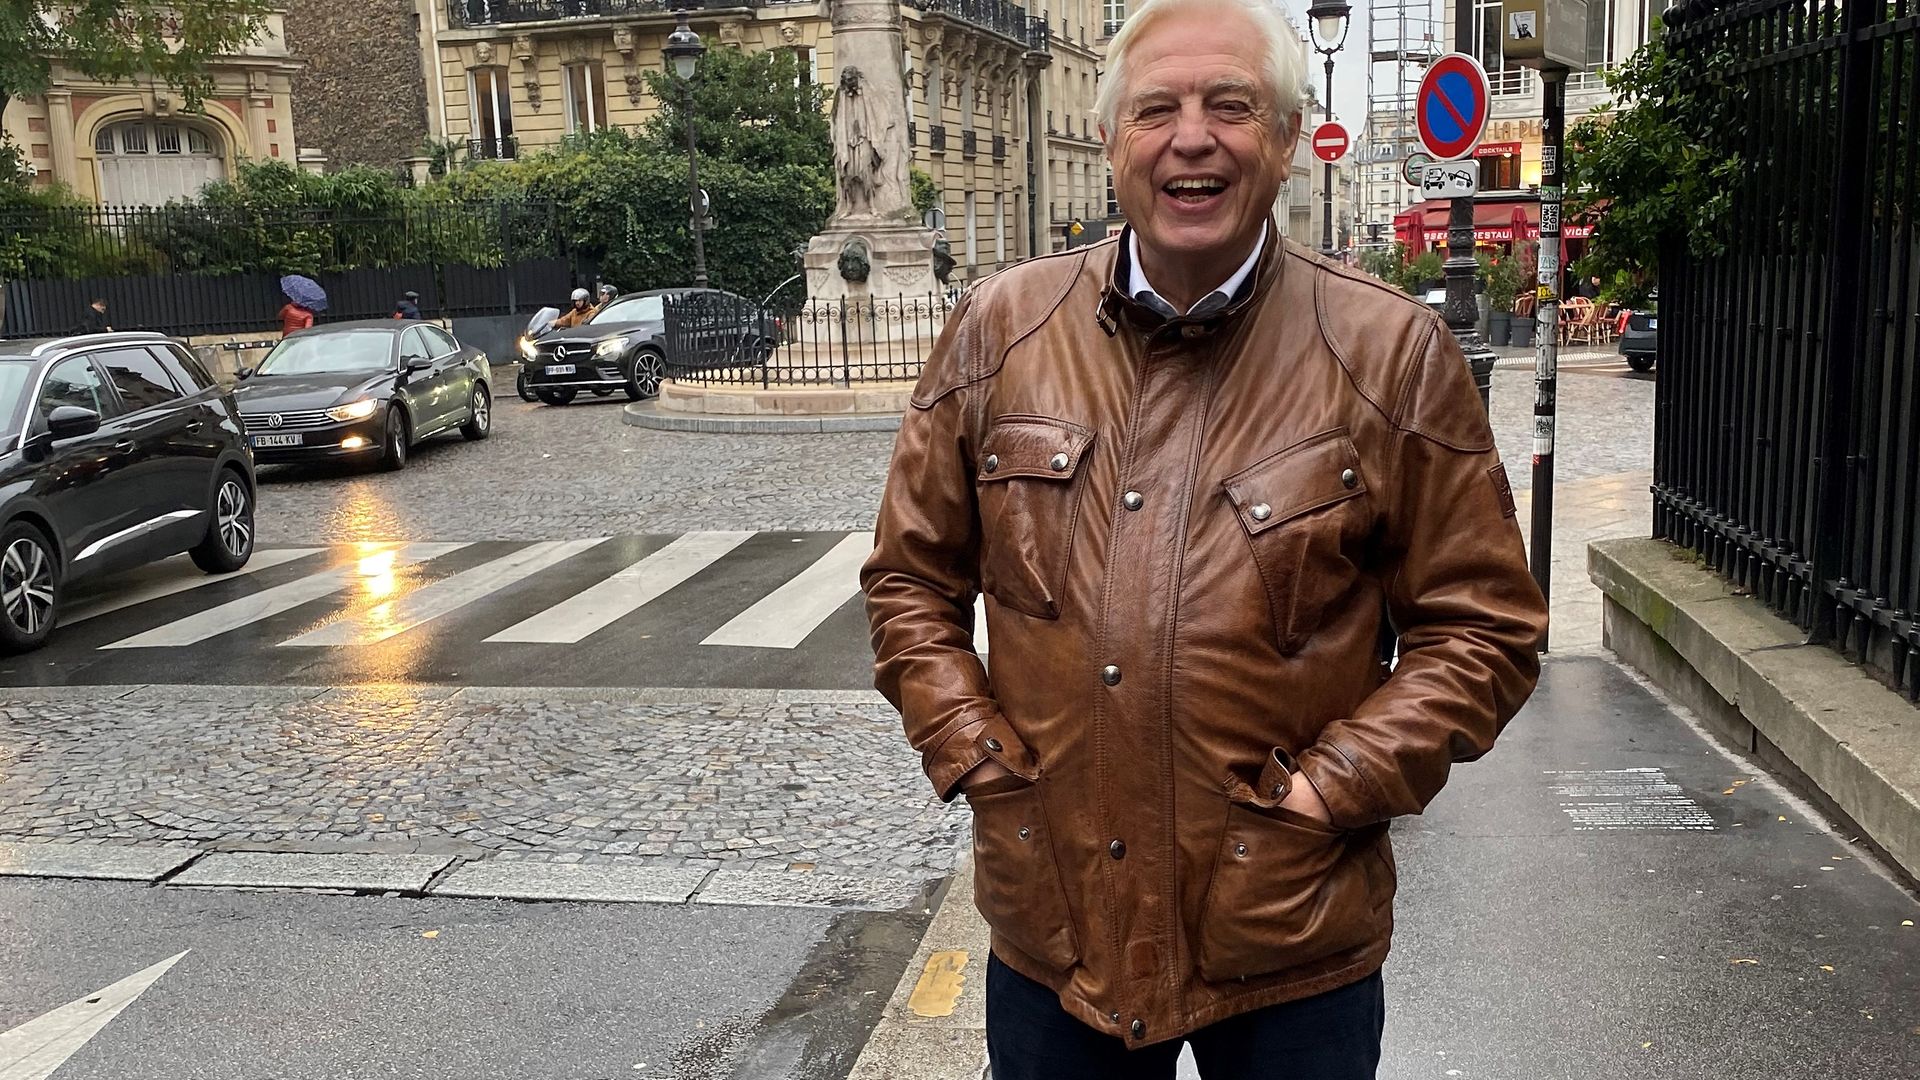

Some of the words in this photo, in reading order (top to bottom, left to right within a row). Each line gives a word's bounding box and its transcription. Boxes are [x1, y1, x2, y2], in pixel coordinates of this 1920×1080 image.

[1495, 121, 1511, 140] LA
[1519, 119, 1543, 138] PLA
[1478, 146, 1513, 154] COCKTAILS
[1564, 228, 1590, 236] VICE
[269, 435, 283, 445] 144
